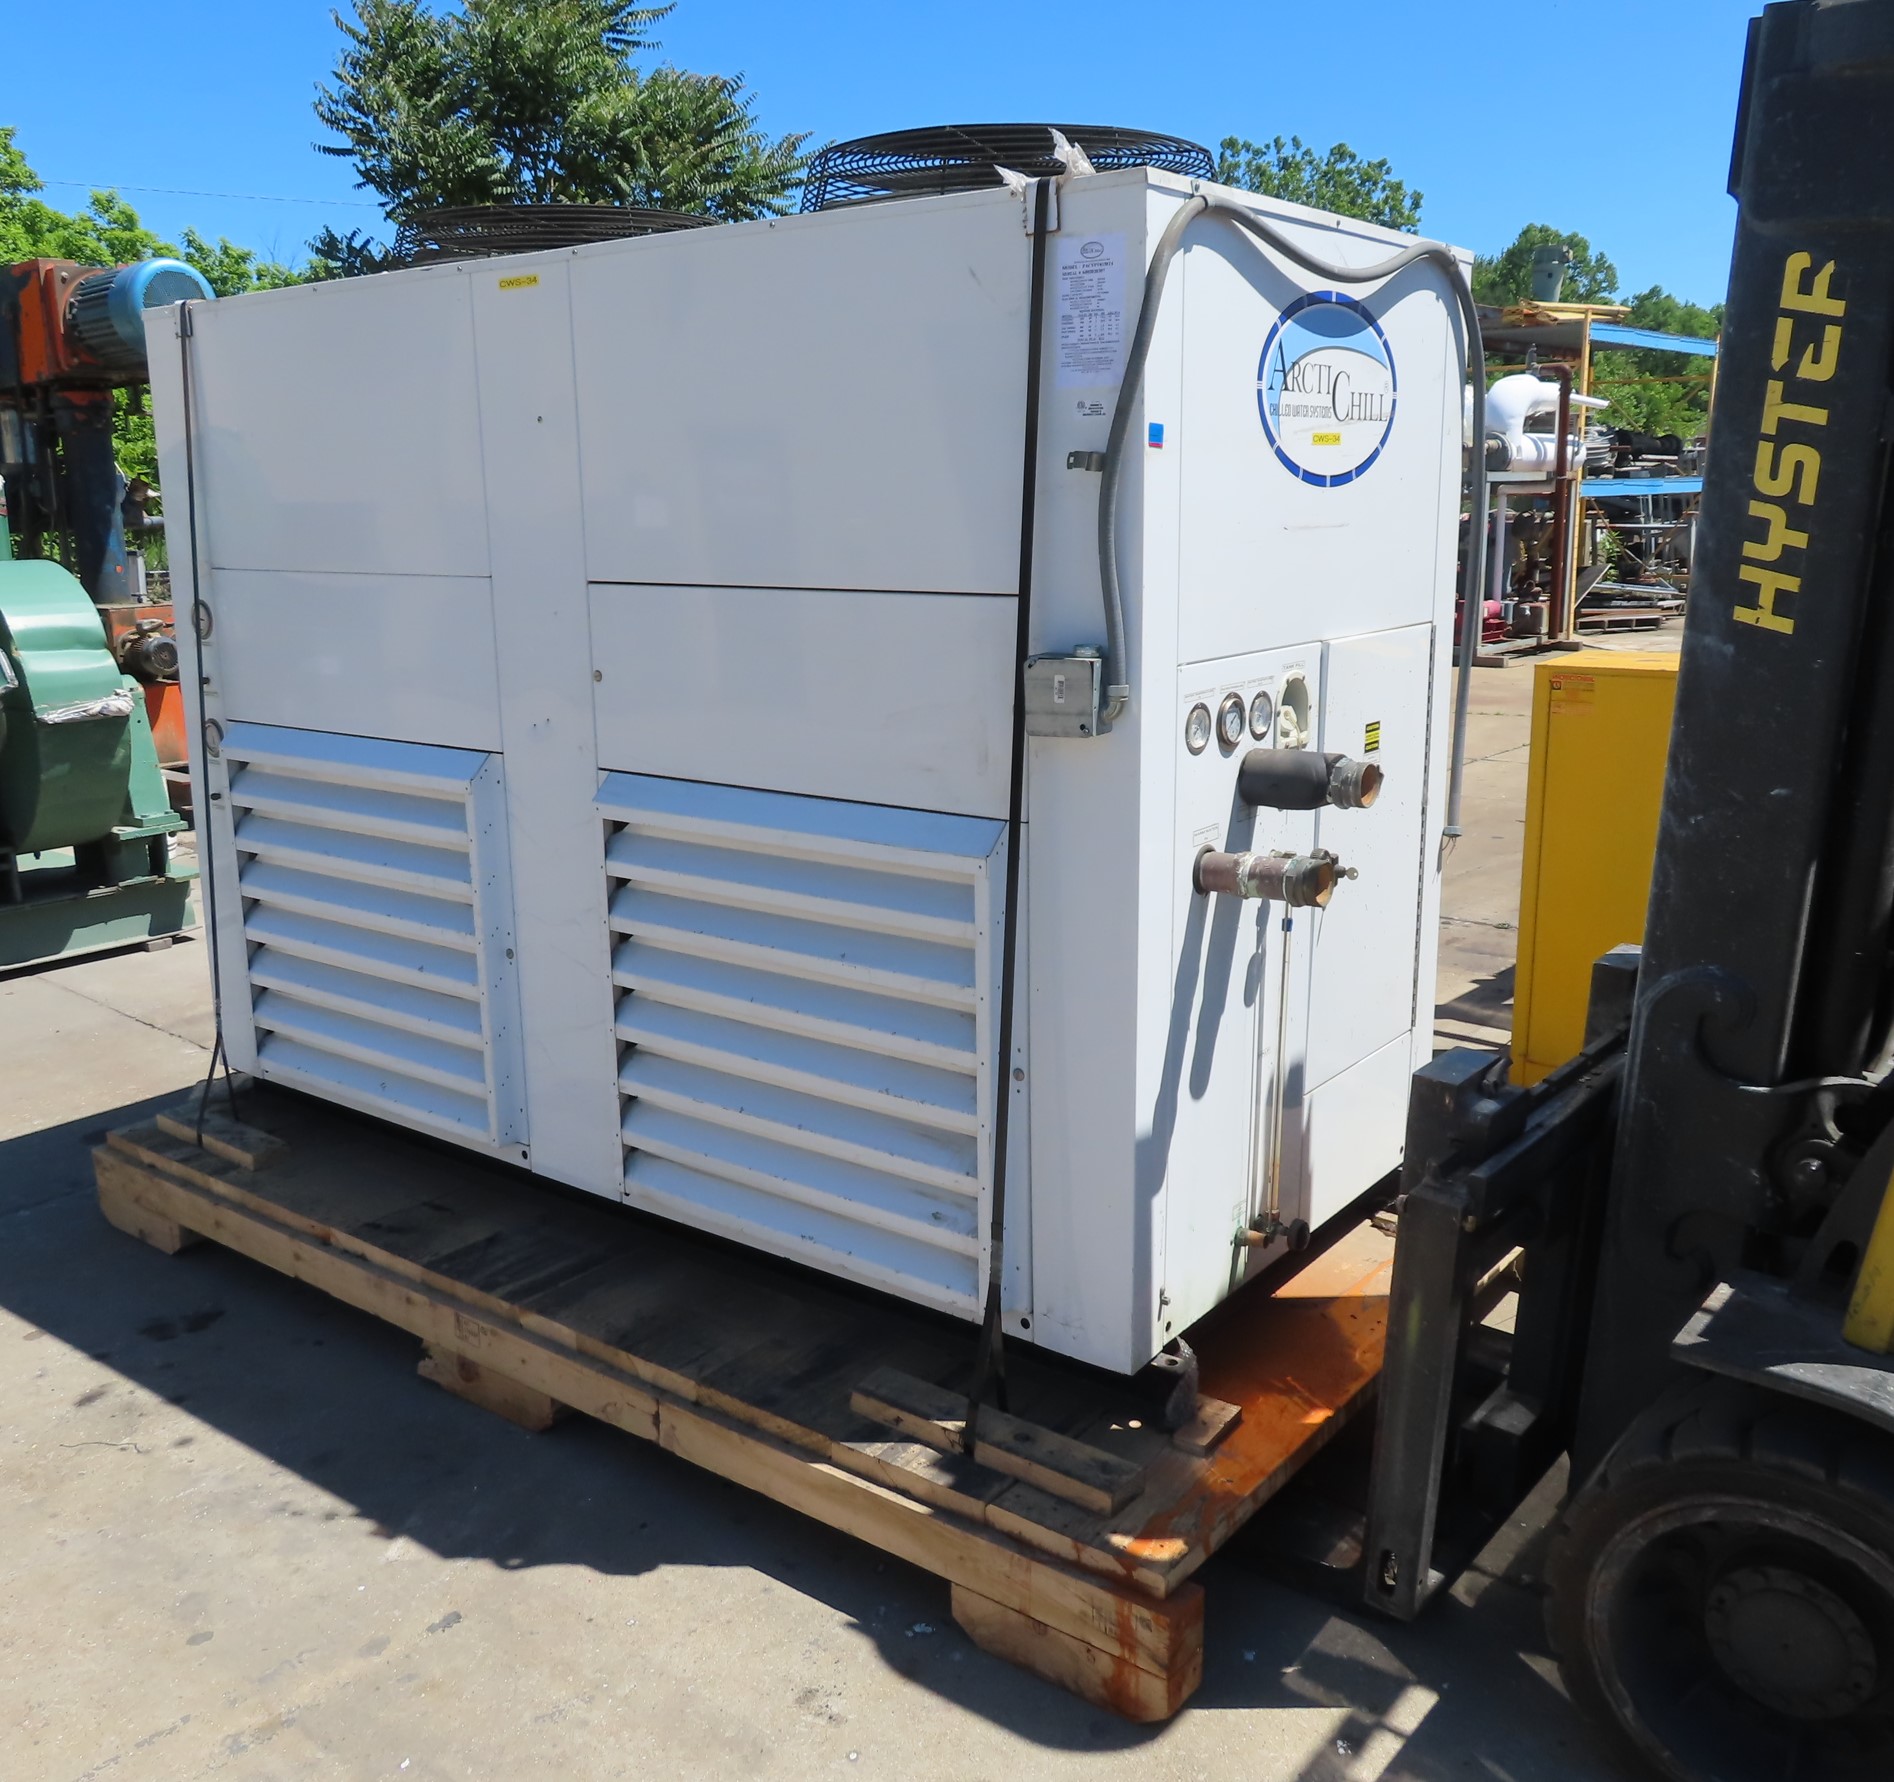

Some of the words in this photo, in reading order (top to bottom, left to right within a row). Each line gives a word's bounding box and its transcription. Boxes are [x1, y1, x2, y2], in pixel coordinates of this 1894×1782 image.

[499, 276, 538, 288] CWS-34
[1291, 404, 1309, 418] WATER
[1309, 404, 1332, 419] SYSTEMS
[1312, 434, 1341, 444] CWS-34
[1732, 251, 1847, 635] HYSTER
